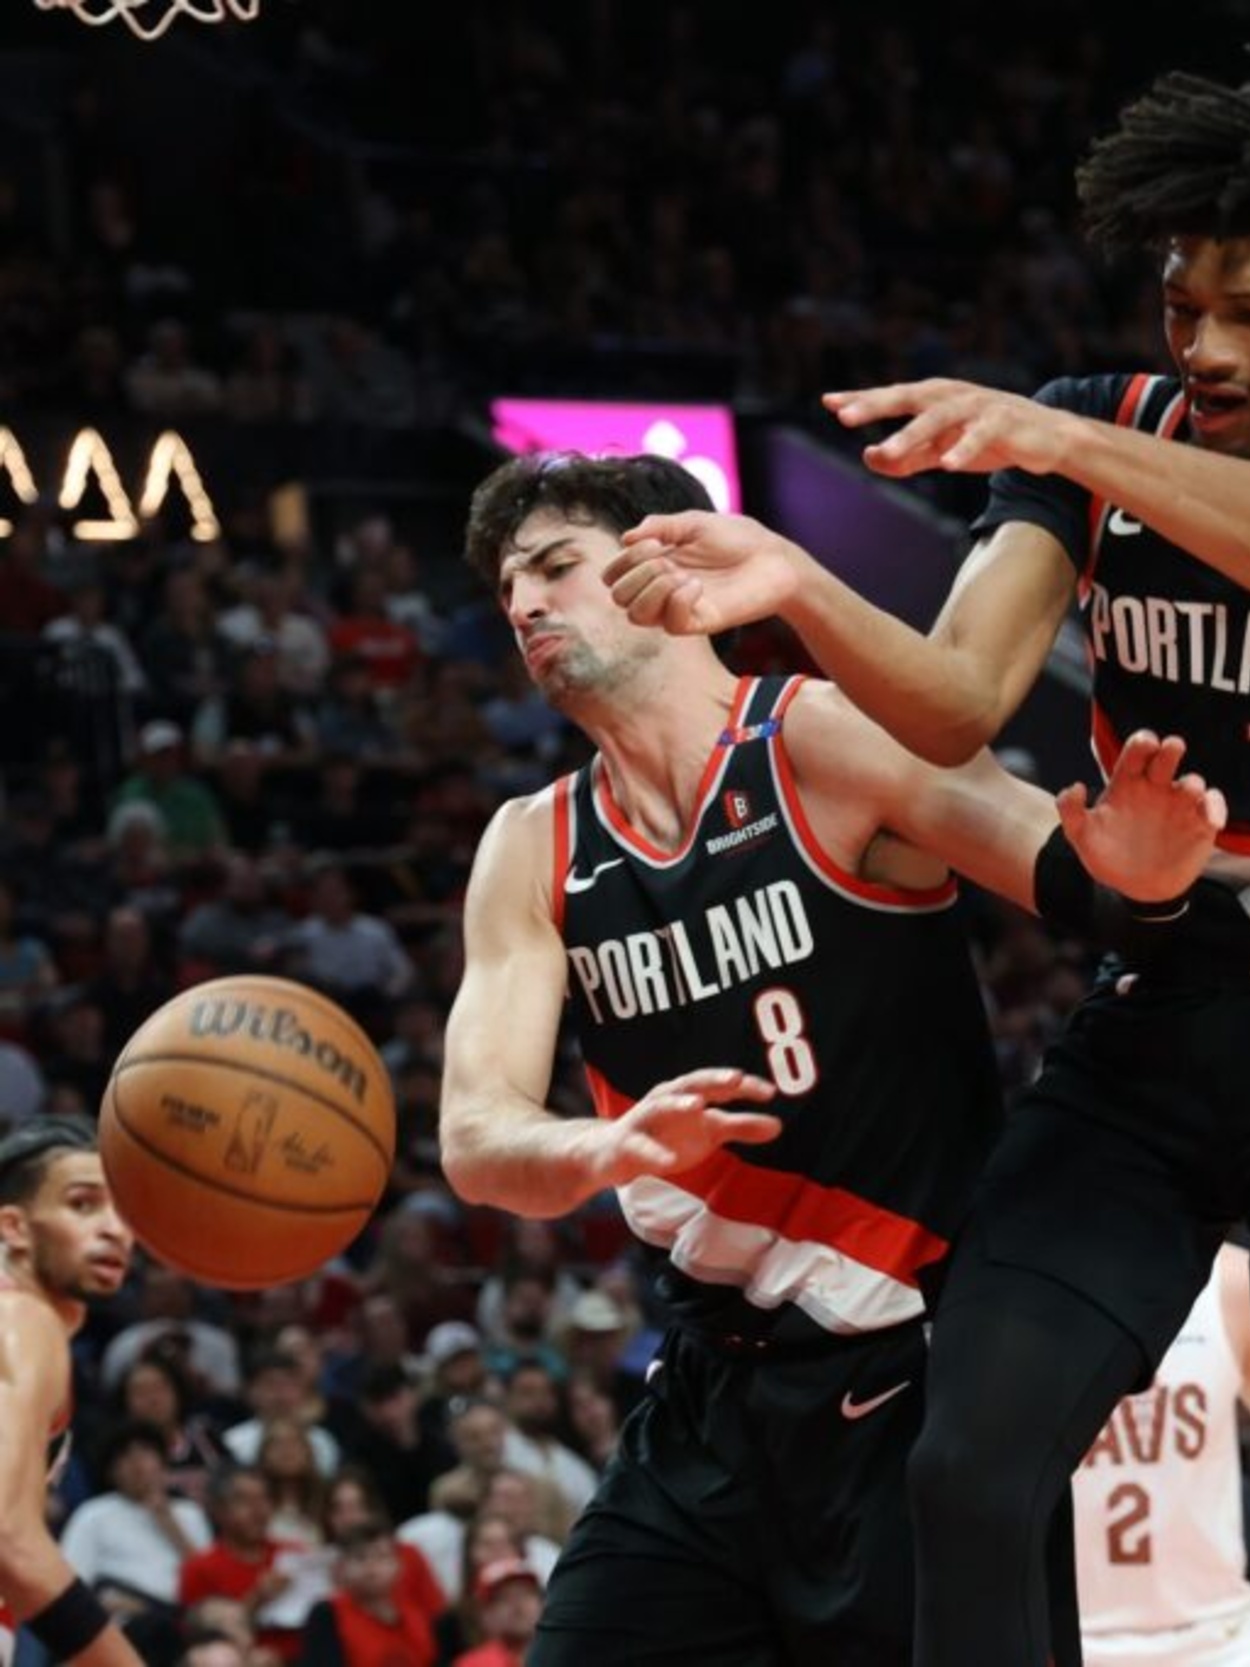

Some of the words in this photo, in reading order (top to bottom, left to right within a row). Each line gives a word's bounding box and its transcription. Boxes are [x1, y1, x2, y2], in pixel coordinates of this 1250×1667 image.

[706, 812, 778, 855] BRIGHTSIDE
[567, 879, 815, 1024] PORTLAND
[189, 999, 368, 1105] Wilson
[754, 985, 818, 1096] 8
[1084, 1381, 1208, 1468] AVS
[1106, 1481, 1153, 1566] 2
